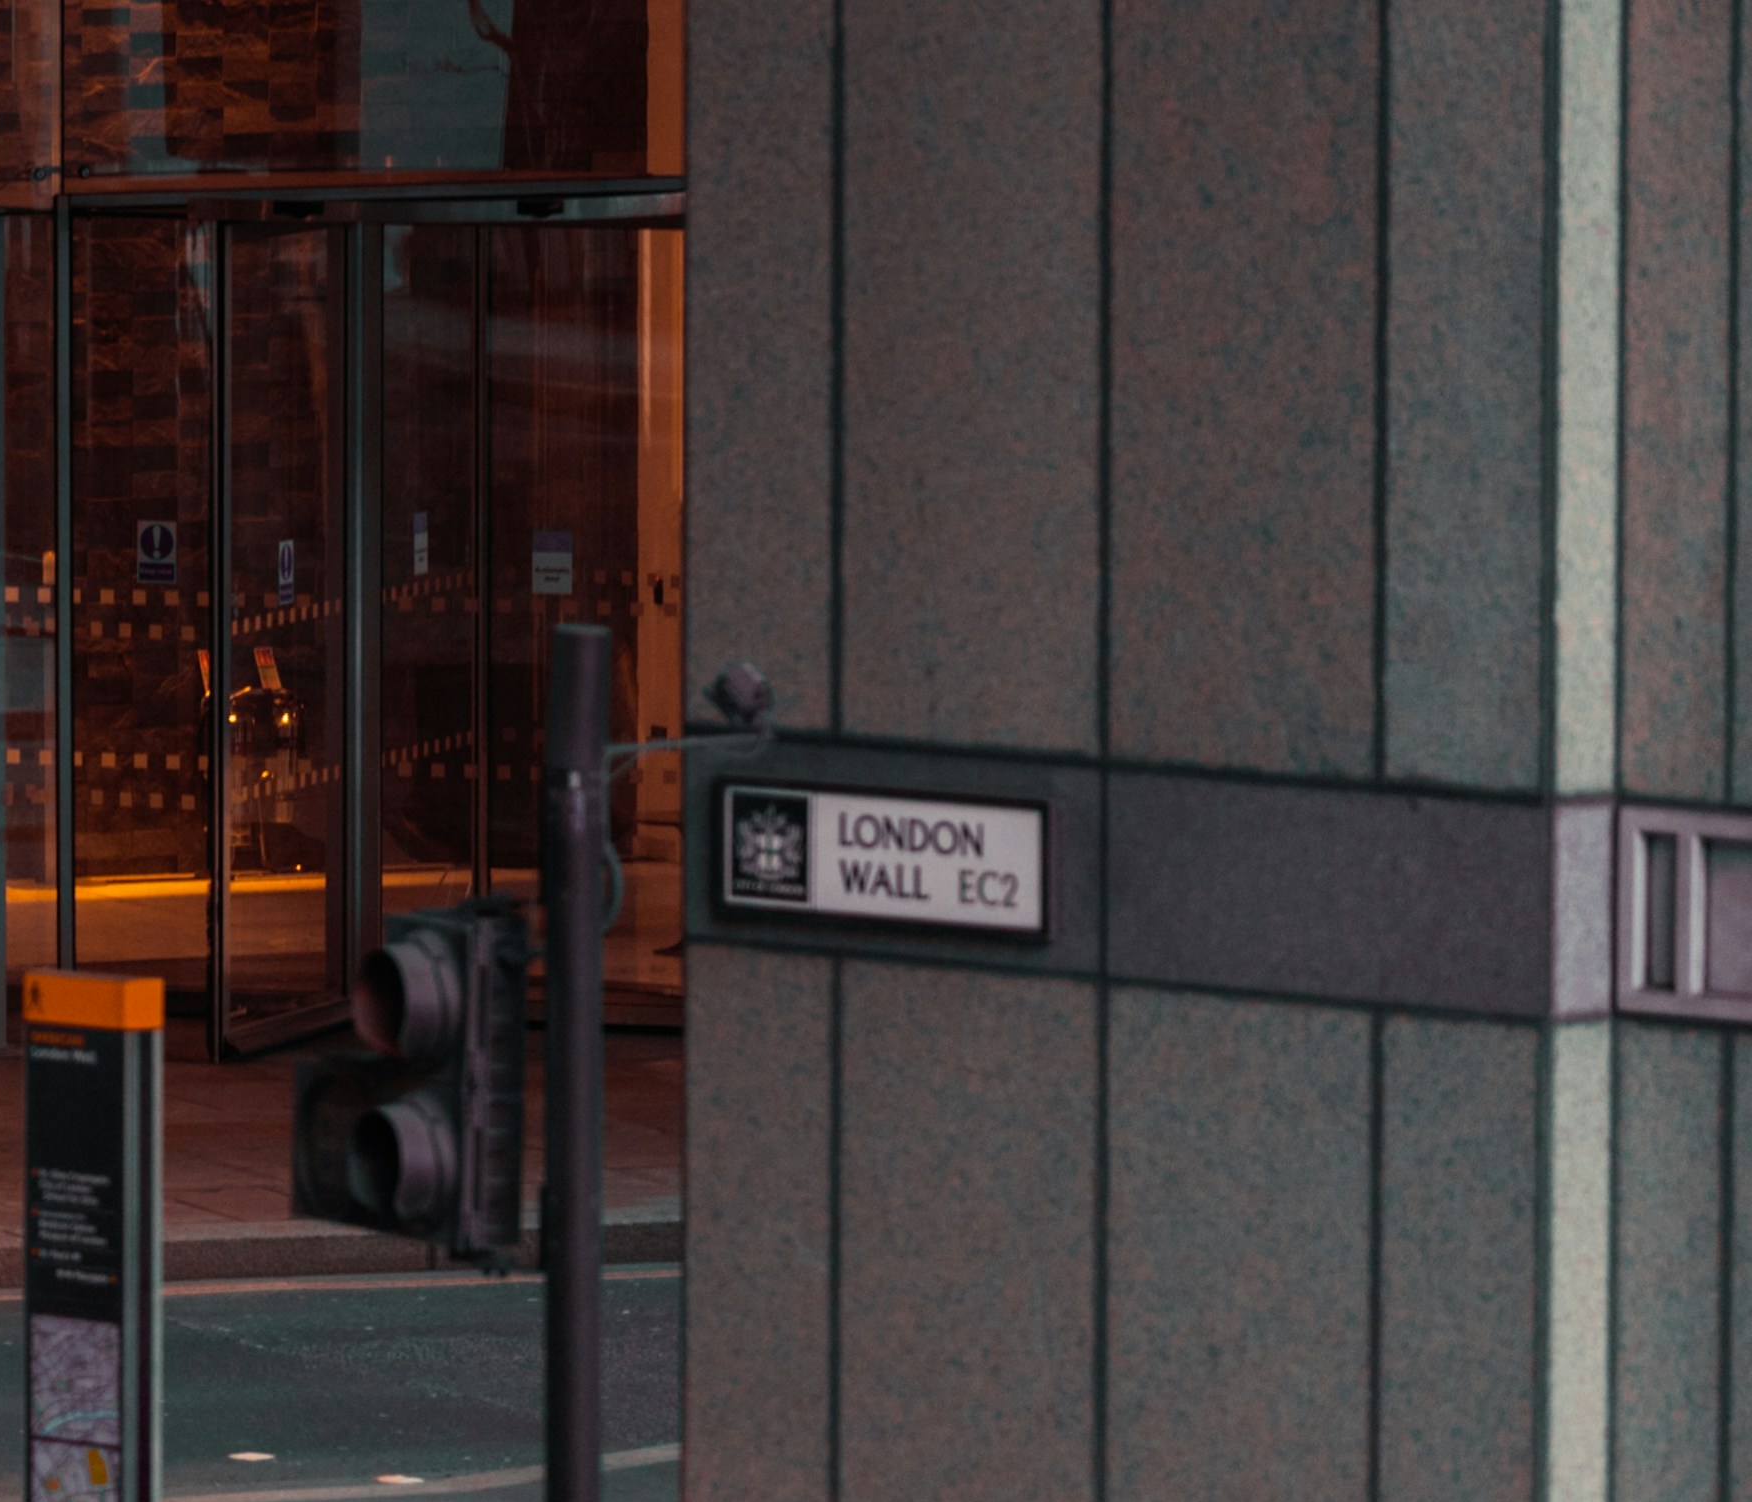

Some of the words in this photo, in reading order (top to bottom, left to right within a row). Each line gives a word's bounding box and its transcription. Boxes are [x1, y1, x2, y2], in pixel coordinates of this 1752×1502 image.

[837, 811, 985, 858] LONDON
[839, 859, 930, 901] WALL
[957, 869, 1020, 908] EC2
